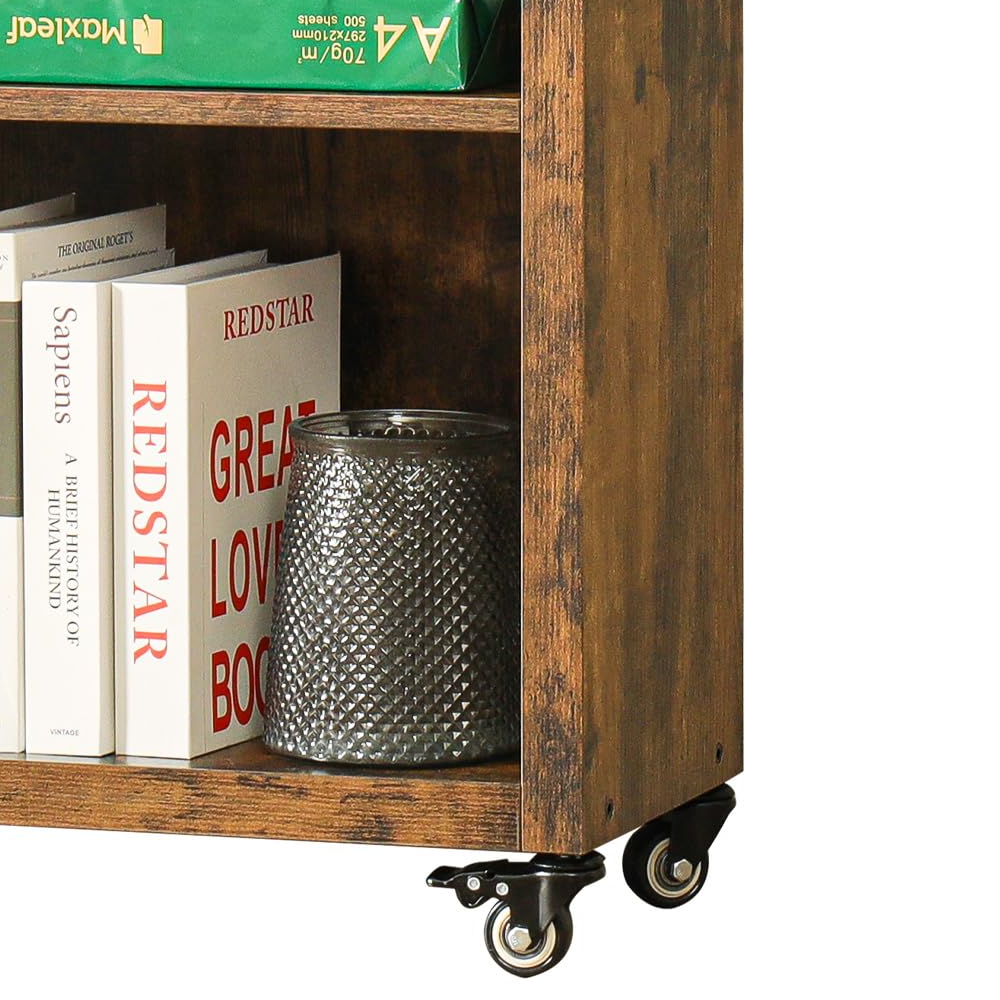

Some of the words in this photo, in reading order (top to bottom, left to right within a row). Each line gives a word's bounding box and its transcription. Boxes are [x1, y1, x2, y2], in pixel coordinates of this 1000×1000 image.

[6, 15, 127, 45] Maxleaf
[292, 29, 366, 42] 297x210mm
[297, 16, 338, 27] sheets
[344, 16, 366, 27] 500
[373, 16, 451, 65] A4
[57, 244, 72, 258] THE
[72, 237, 105, 255] ORIGINAL
[222, 293, 315, 342] REDSTAR
[45, 305, 77, 424] Sapiens
[65, 453, 77, 466] A
[210, 399, 316, 503] GREA
[65, 476, 78, 530] BRIEF
[132, 380, 169, 664] REDSTAR
[48, 489, 62, 609] HUMANKIND
[210, 519, 284, 618] LOV
[66, 534, 79, 618] HISTORY
[67, 621, 79, 647] OF
[49, 728, 80, 737] VINTAGE
